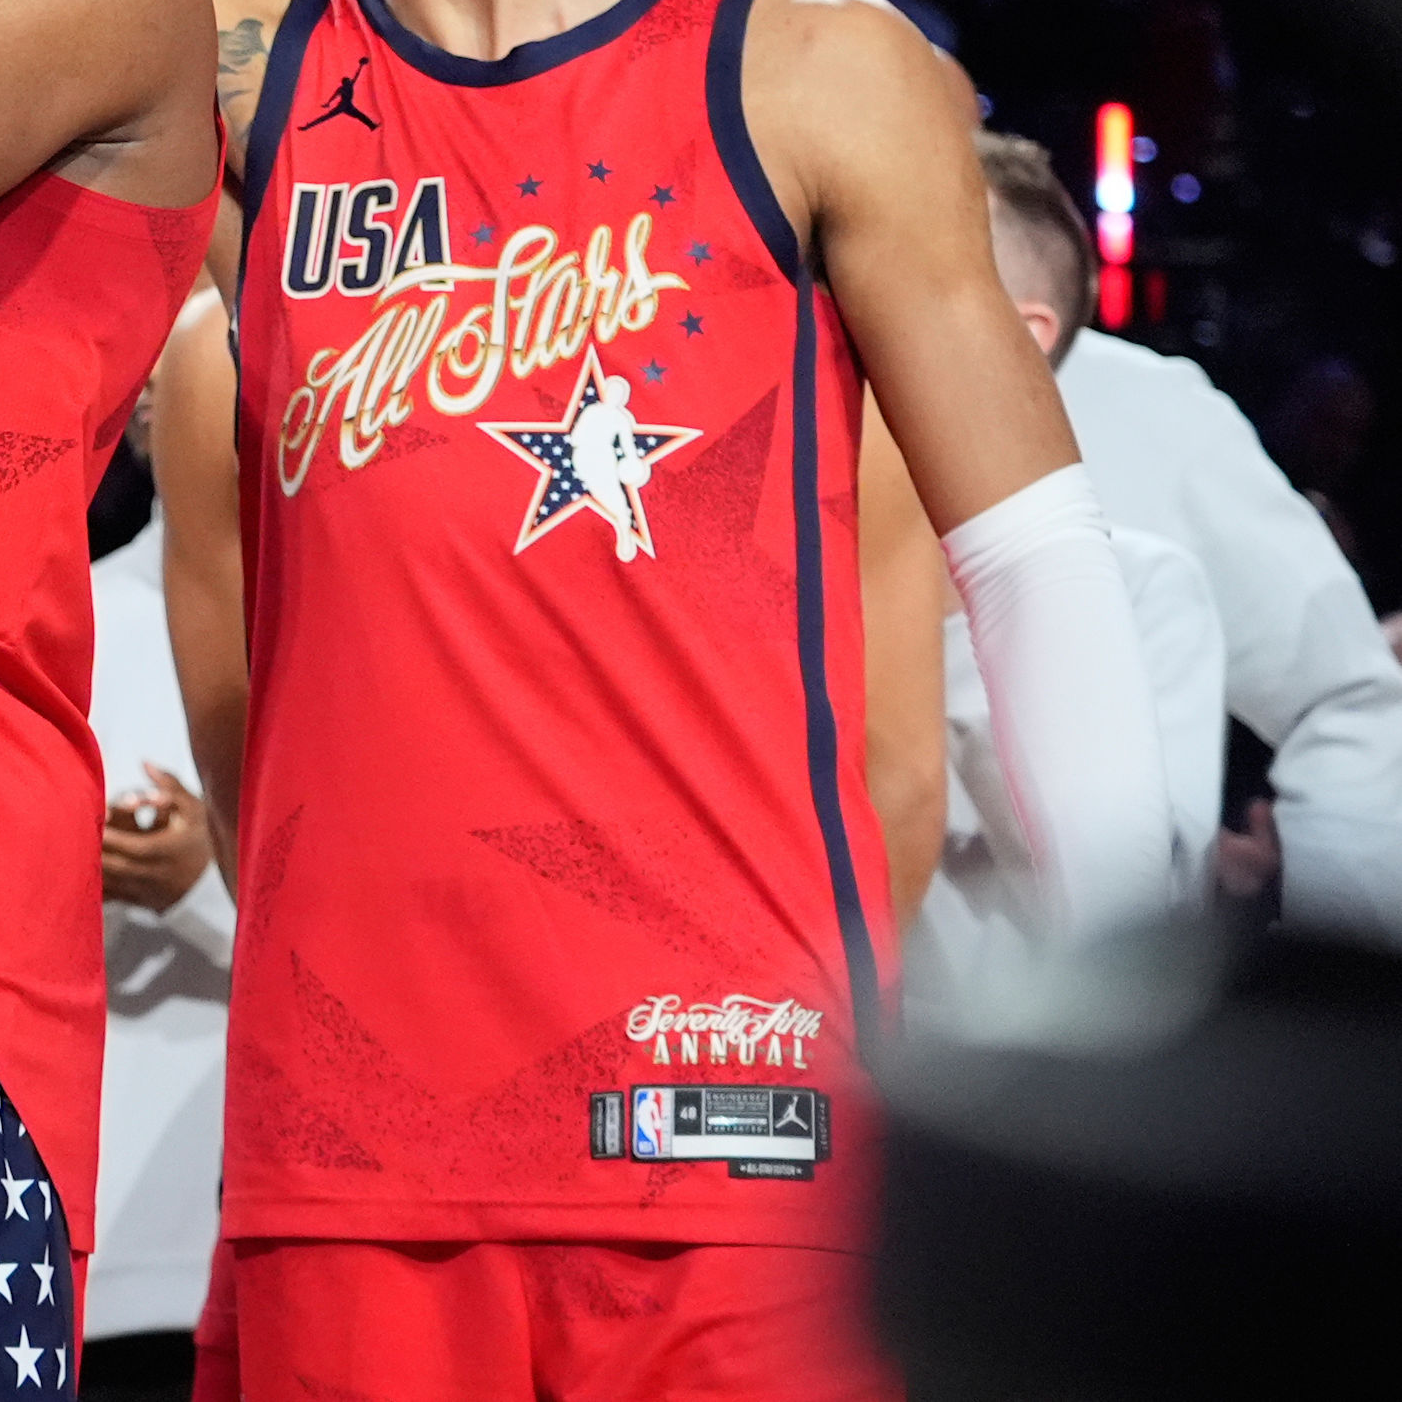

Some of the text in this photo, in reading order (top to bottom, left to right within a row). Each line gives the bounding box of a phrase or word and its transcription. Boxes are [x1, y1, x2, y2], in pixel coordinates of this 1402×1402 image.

[280, 176, 455, 299] USA
[278, 212, 691, 498] All Stars
[625, 994, 824, 1045] Seventy Fifth
[652, 1032, 808, 1070] ANNUAL
